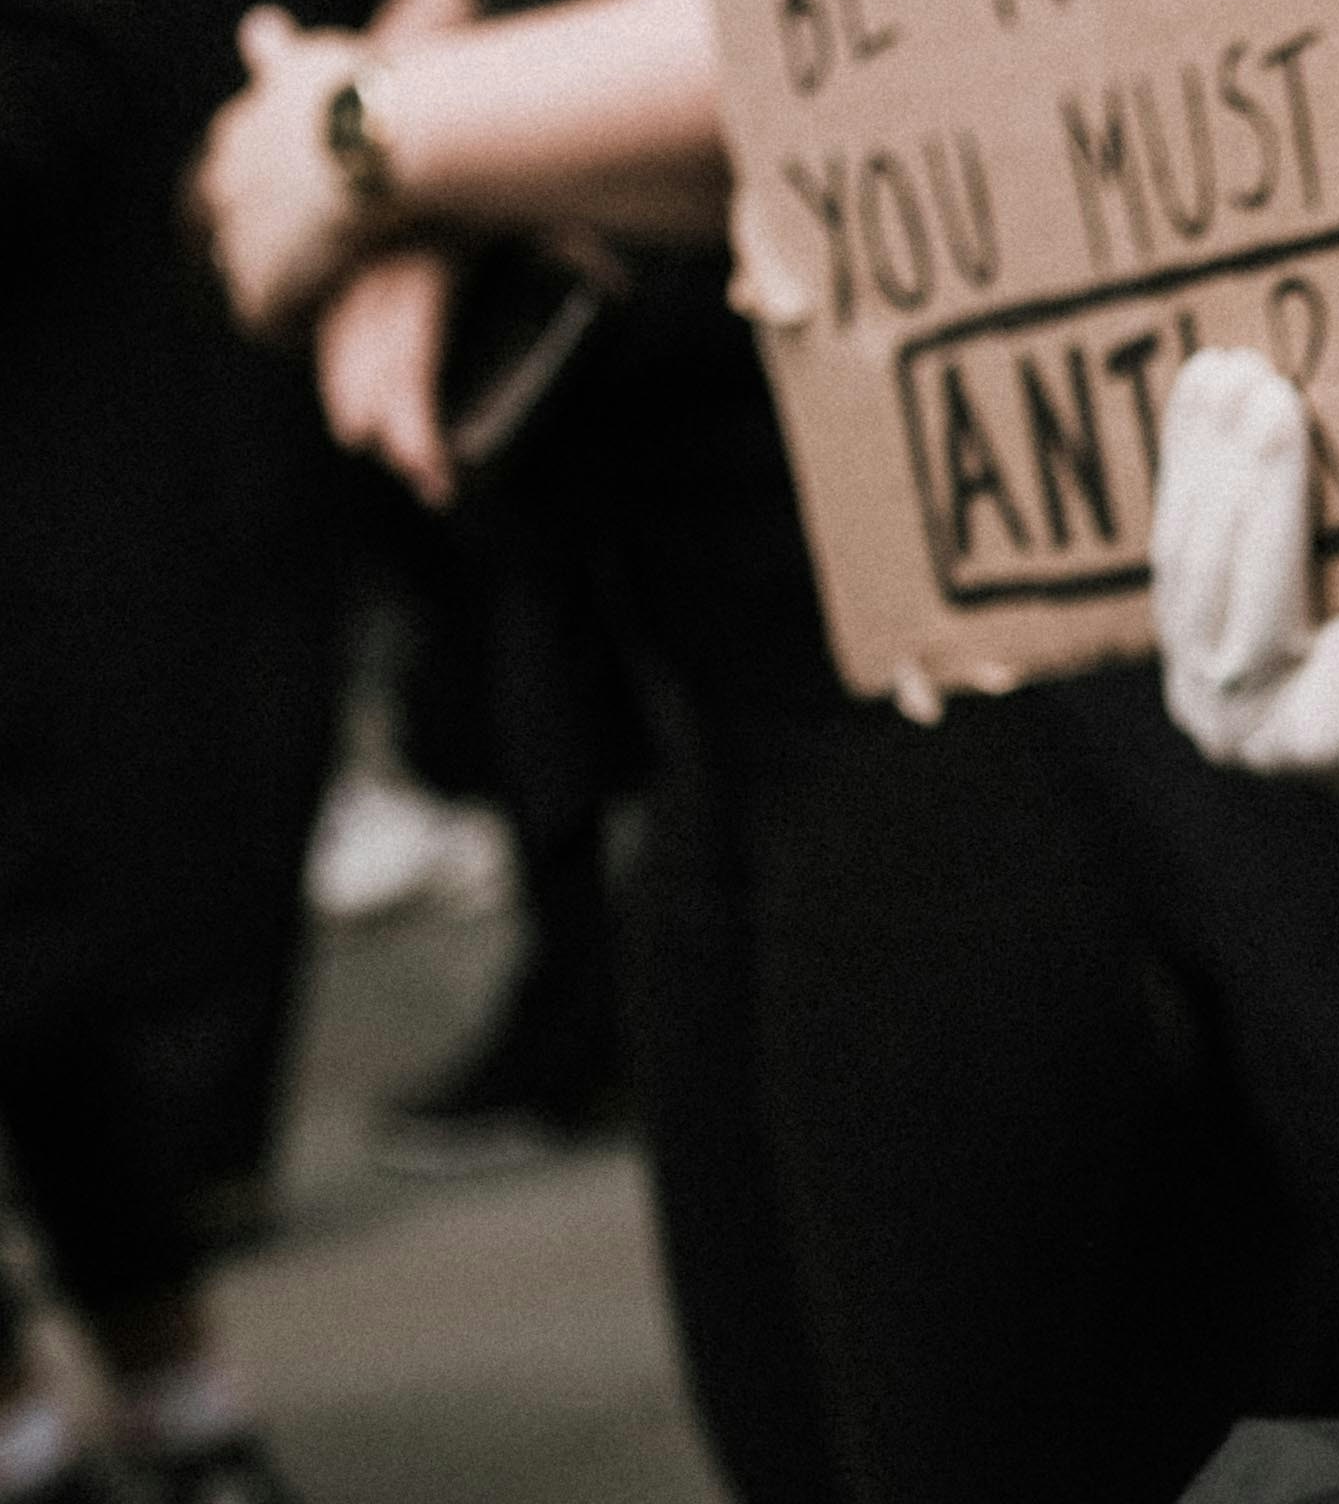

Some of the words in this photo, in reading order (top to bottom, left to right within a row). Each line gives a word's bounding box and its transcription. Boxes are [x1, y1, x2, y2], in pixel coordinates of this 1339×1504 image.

[785, 126, 998, 321] YOU
[1058, 26, 1325, 271] MUST
[935, 311, 1202, 566] ANT
